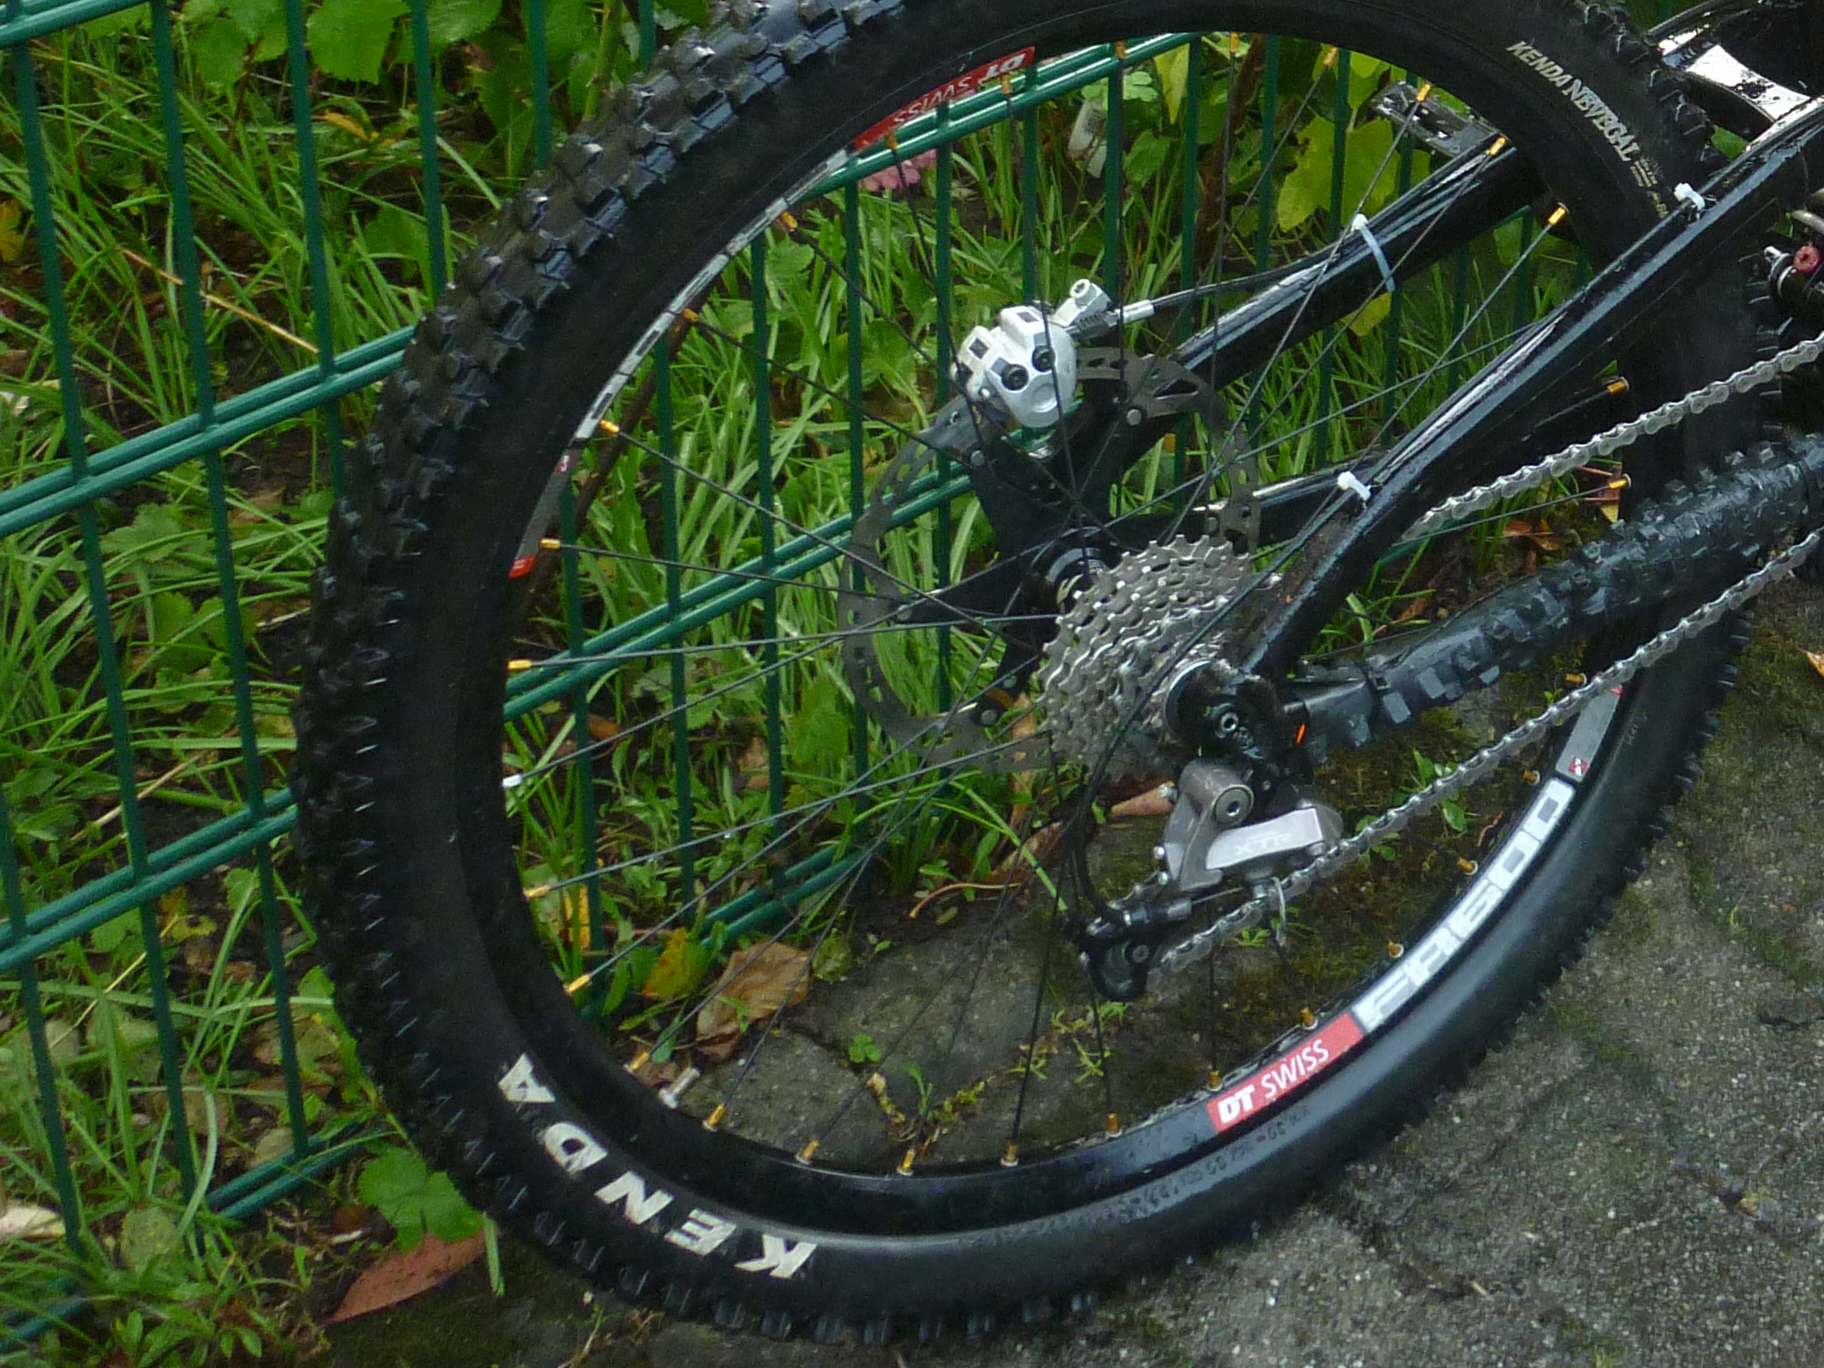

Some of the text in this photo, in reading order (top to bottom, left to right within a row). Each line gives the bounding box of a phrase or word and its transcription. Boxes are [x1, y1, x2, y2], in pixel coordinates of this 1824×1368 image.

[893, 52, 1027, 124] DT SWISS
[1506, 40, 1641, 162] KENDA NEVEGAL
[1217, 1038, 1329, 1125] DT SWISS
[498, 1052, 818, 1280] KENDA
